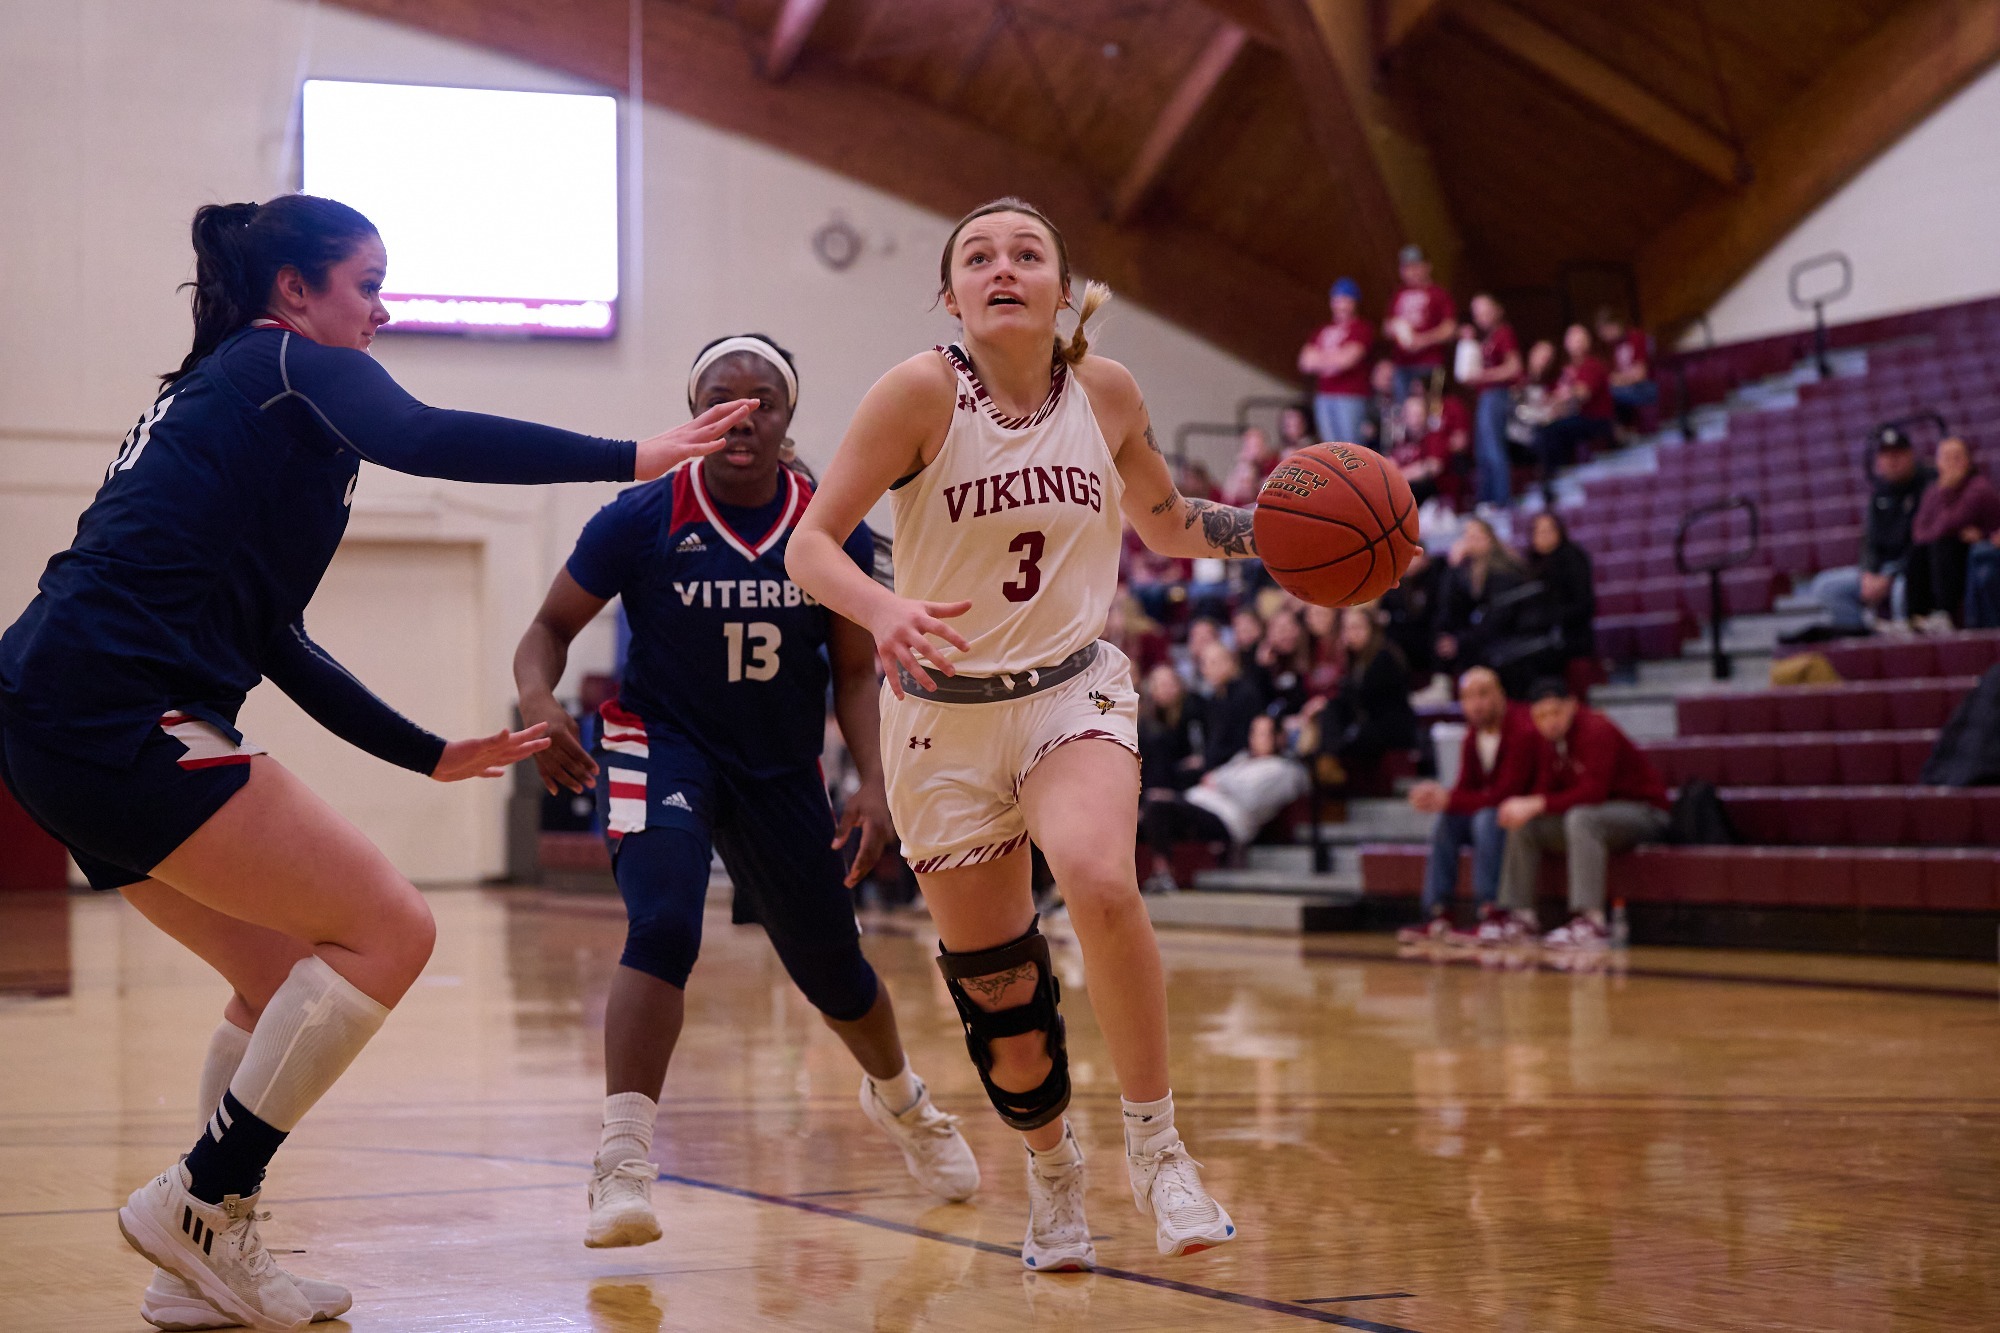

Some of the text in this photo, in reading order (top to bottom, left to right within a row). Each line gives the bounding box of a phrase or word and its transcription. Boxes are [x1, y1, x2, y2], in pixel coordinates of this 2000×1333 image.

[943, 465, 1101, 523] VIKINGS
[1002, 530, 1046, 602] 3
[723, 621, 782, 682] 13
